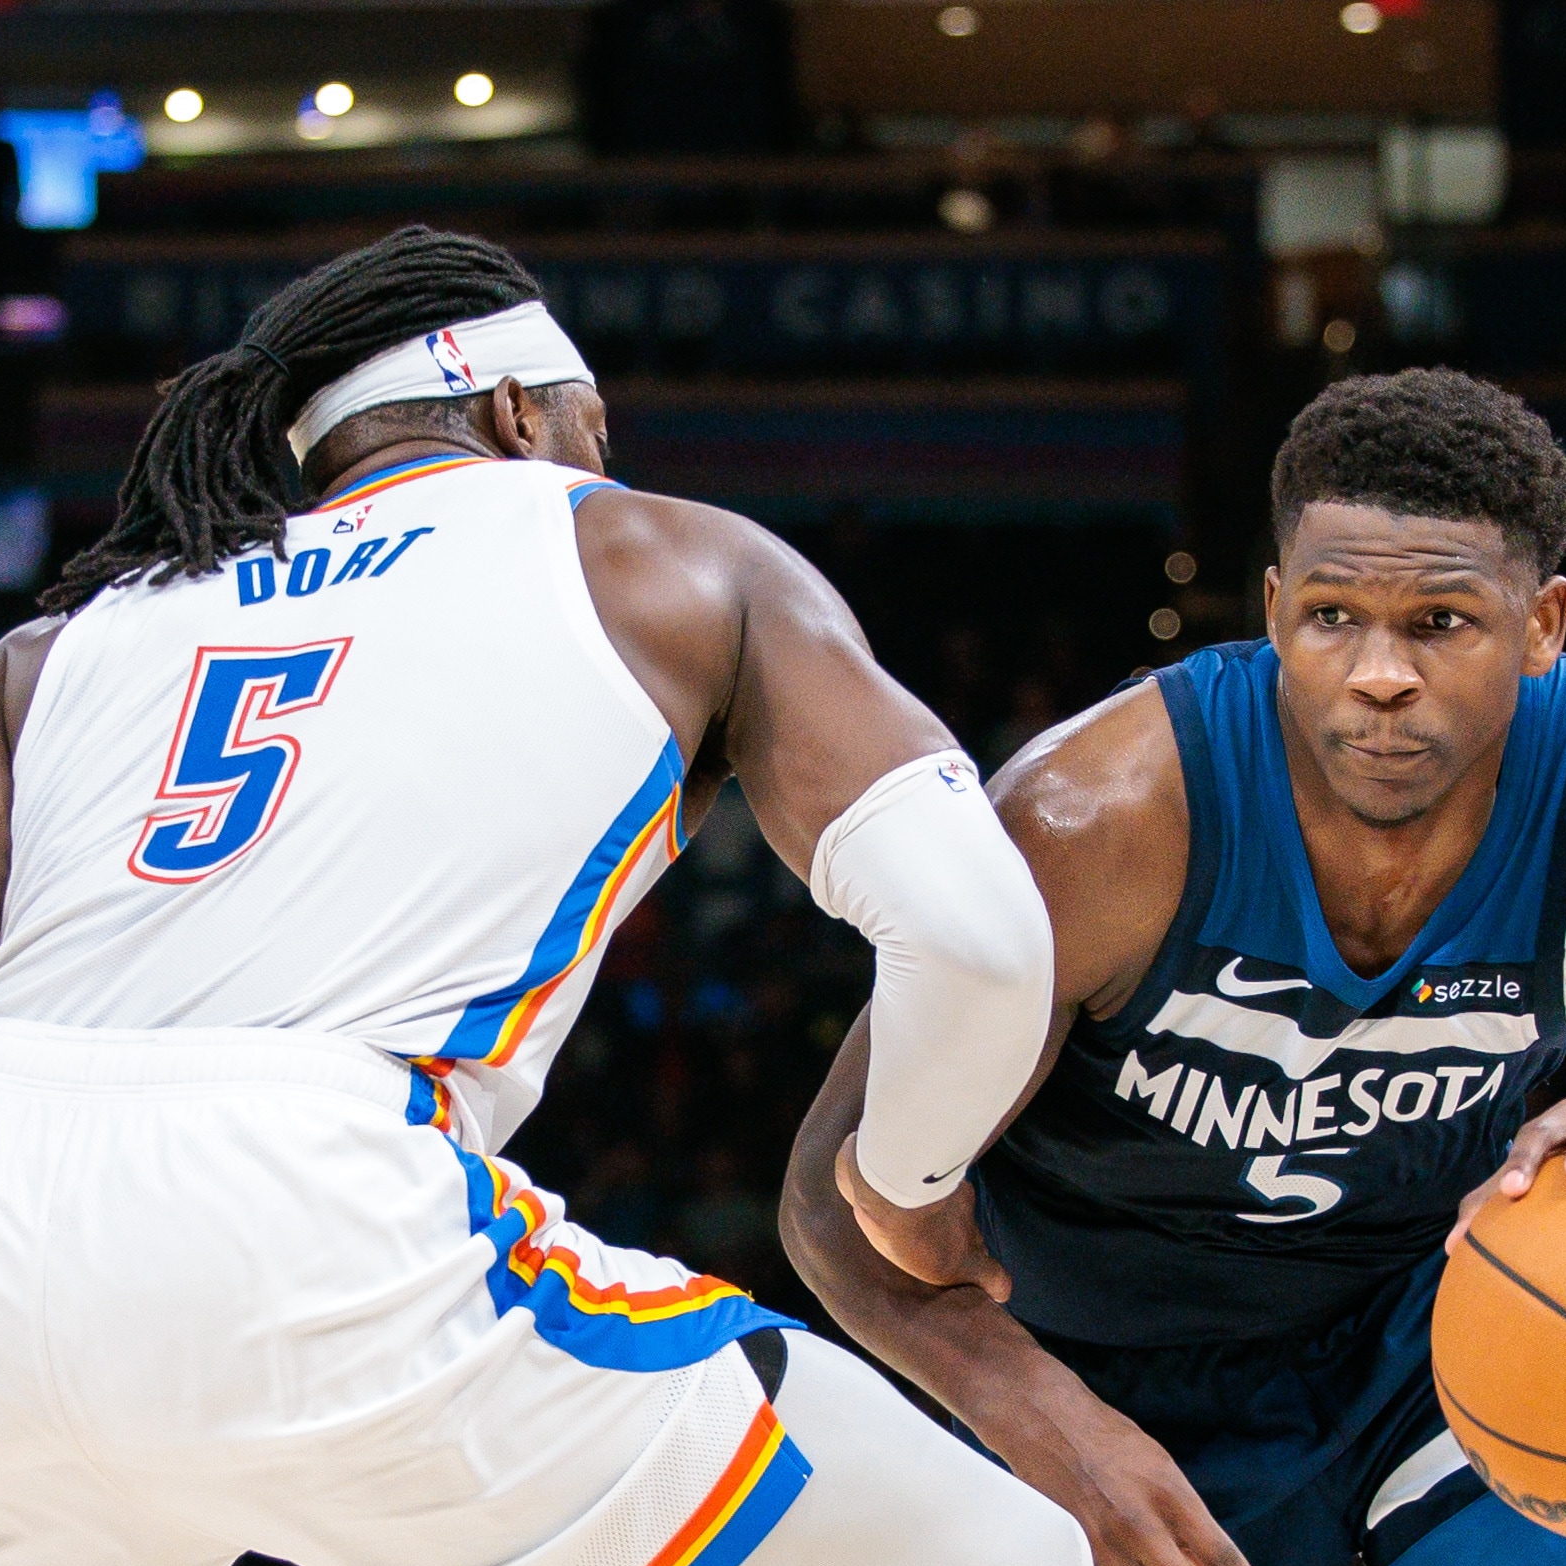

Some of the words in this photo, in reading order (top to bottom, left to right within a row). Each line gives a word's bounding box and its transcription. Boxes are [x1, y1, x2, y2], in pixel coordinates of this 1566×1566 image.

[236, 526, 436, 608] DORT
[127, 635, 355, 886] 5
[1434, 974, 1521, 1003] sezzle
[1114, 1049, 1506, 1150] MINNESOTA
[1236, 1147, 1355, 1223] 5
